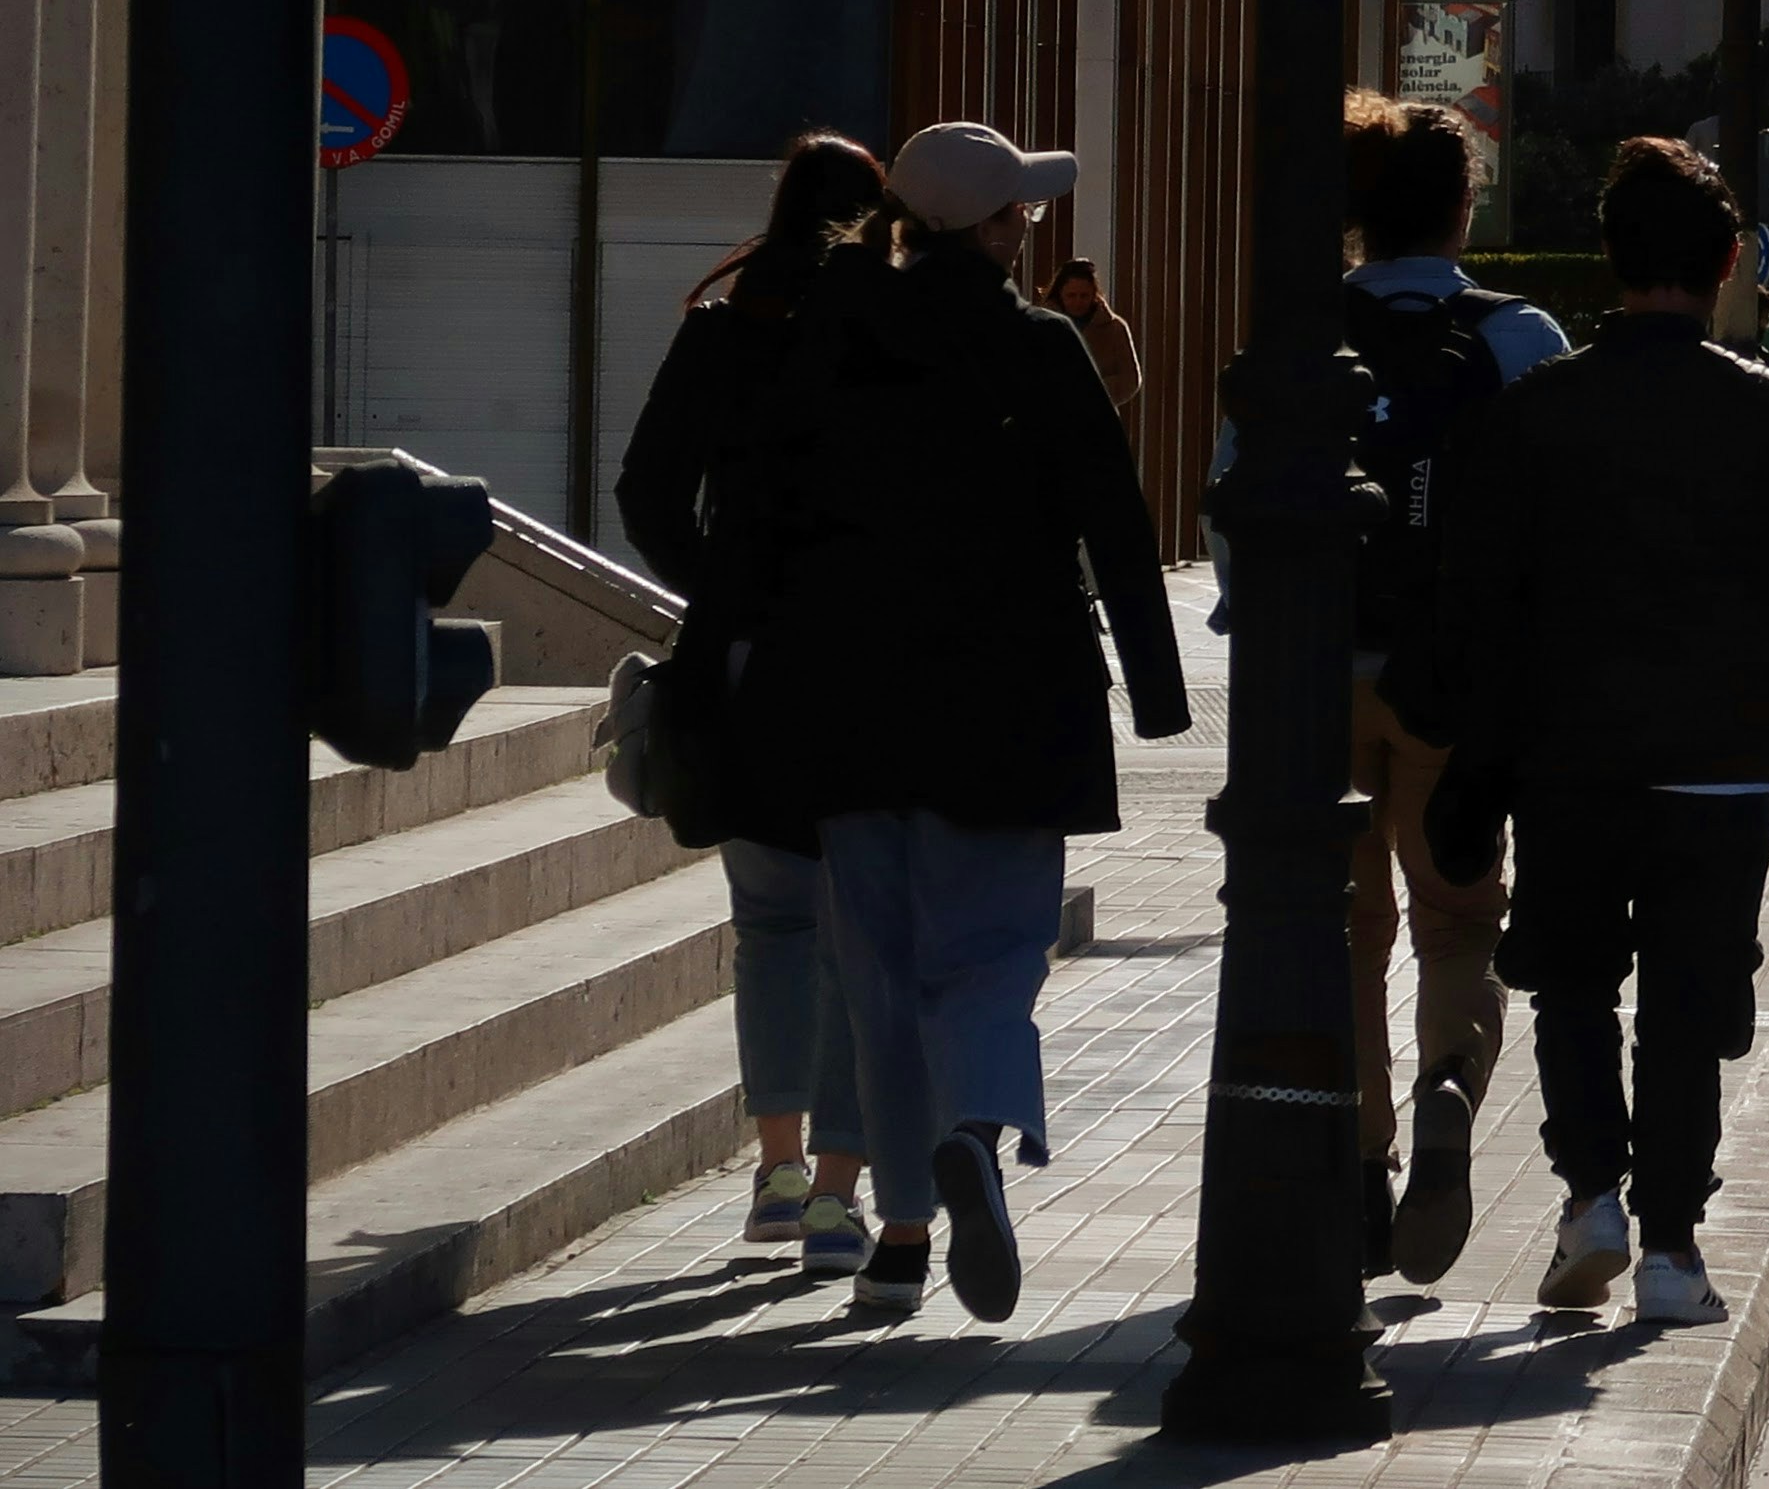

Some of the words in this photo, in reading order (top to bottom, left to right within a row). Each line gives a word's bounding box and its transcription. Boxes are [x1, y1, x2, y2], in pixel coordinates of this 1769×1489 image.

[1400, 66, 1442, 78] solar
[1401, 79, 1462, 93] alència,
[370, 100, 407, 150] GOMIL
